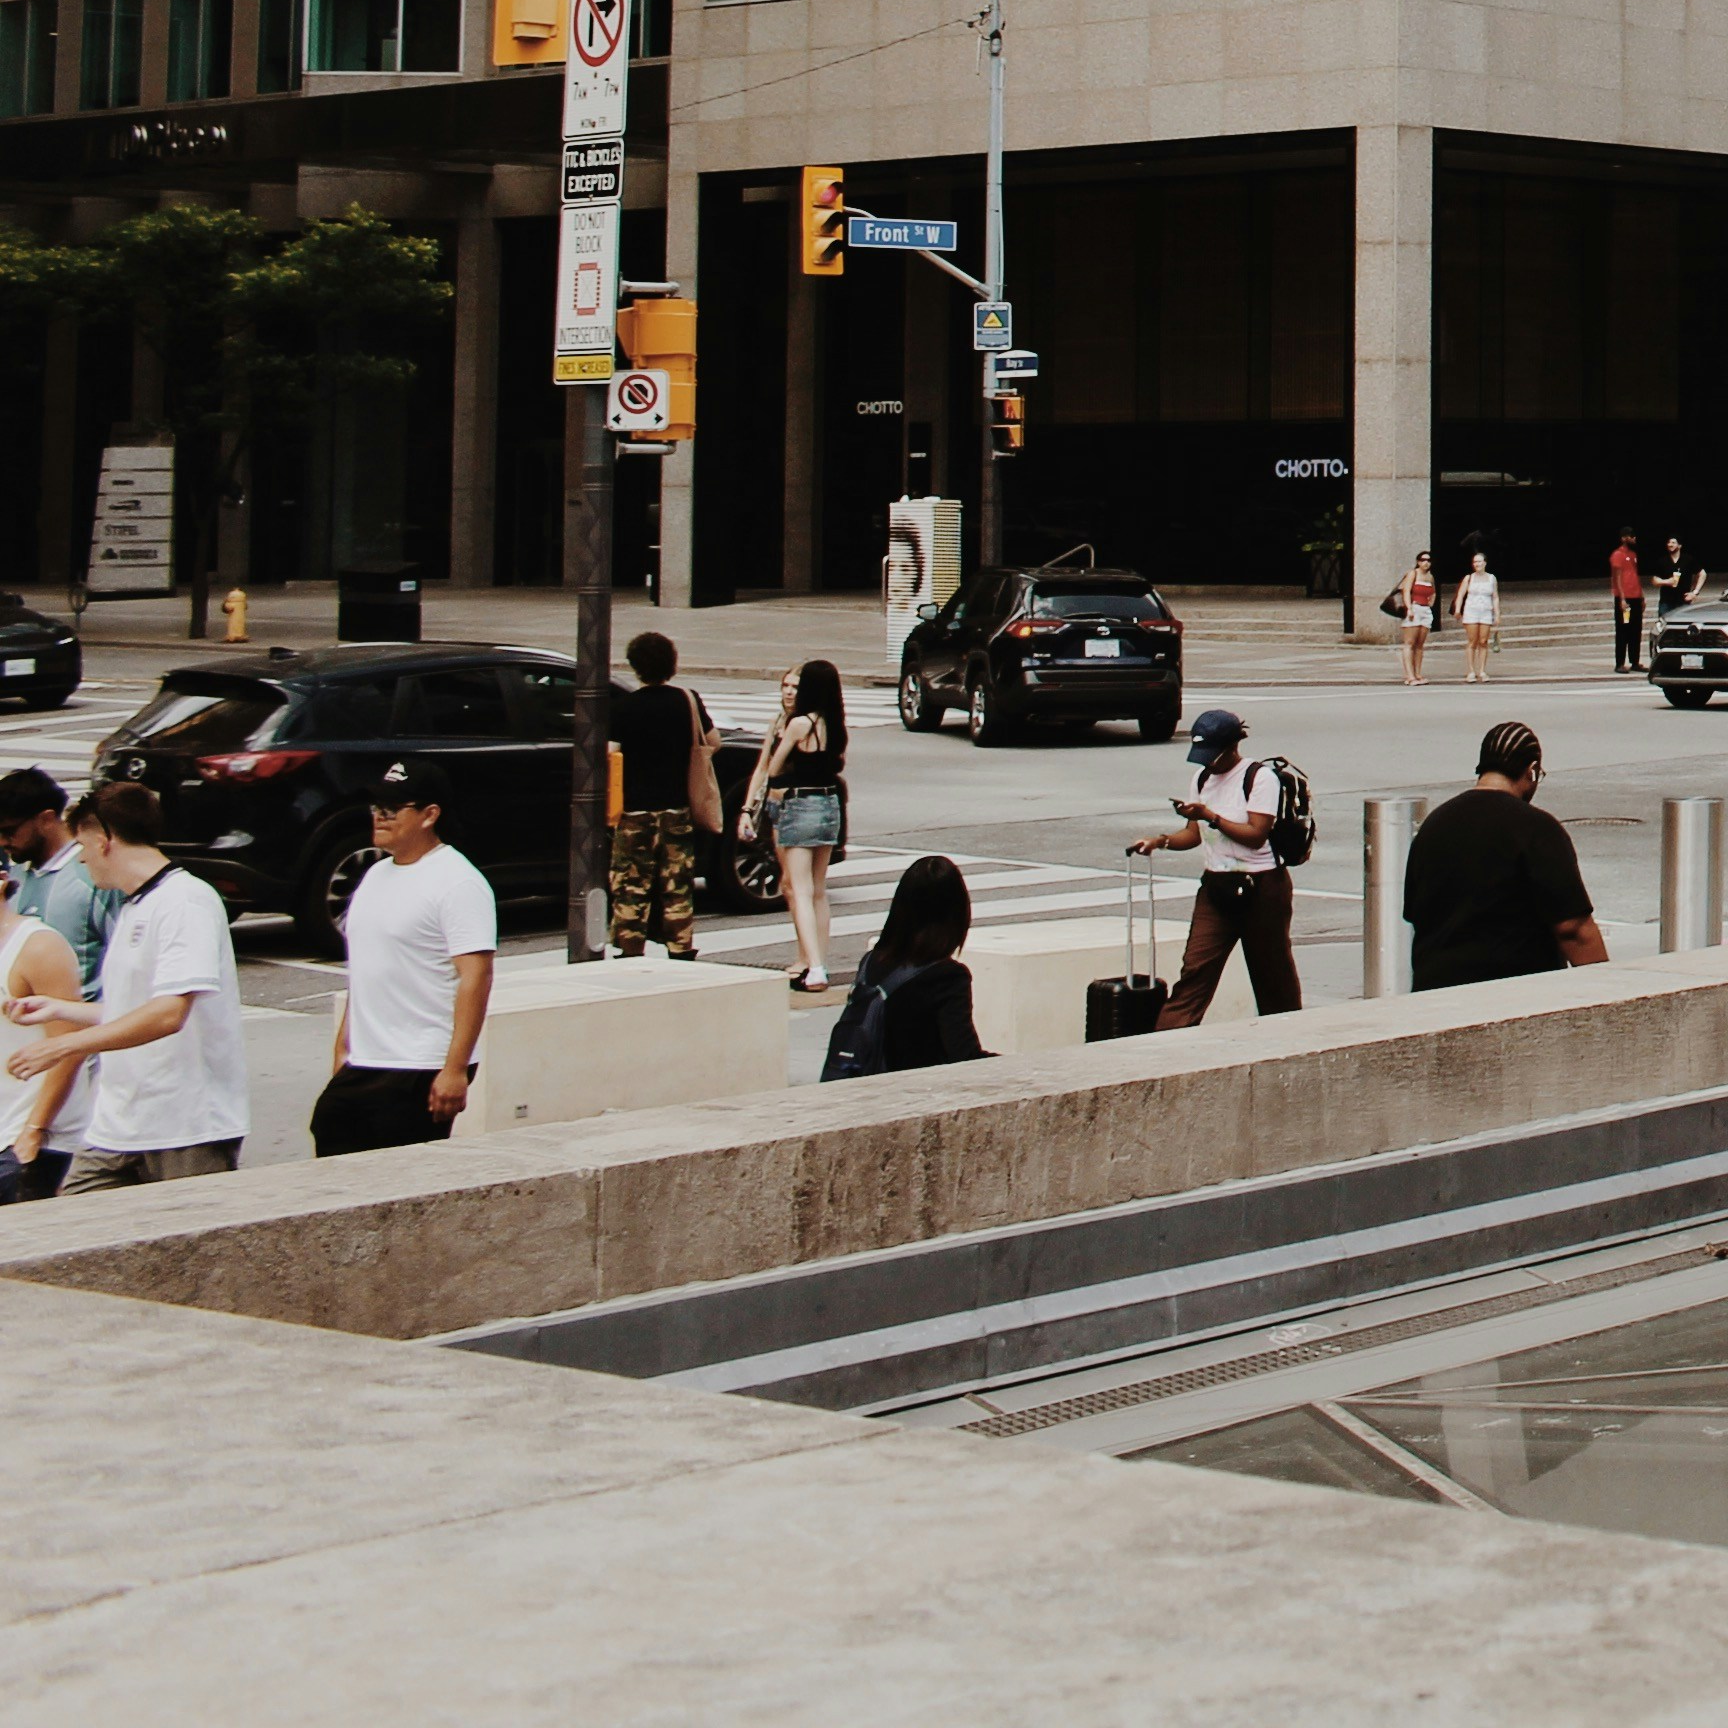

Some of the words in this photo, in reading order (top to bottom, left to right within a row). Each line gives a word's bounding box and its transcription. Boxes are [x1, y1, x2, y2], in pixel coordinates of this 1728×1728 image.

[568, 172, 616, 193] EXCEPTED
[574, 213, 587, 231] DO
[587, 210, 606, 230] NOT
[865, 222, 910, 244] Front
[914, 224, 924, 236] St
[926, 225, 940, 244] W
[575, 235, 603, 254] BLOCK
[559, 326, 612, 346] INTERSECTION
[857, 401, 903, 414] CHOTTO
